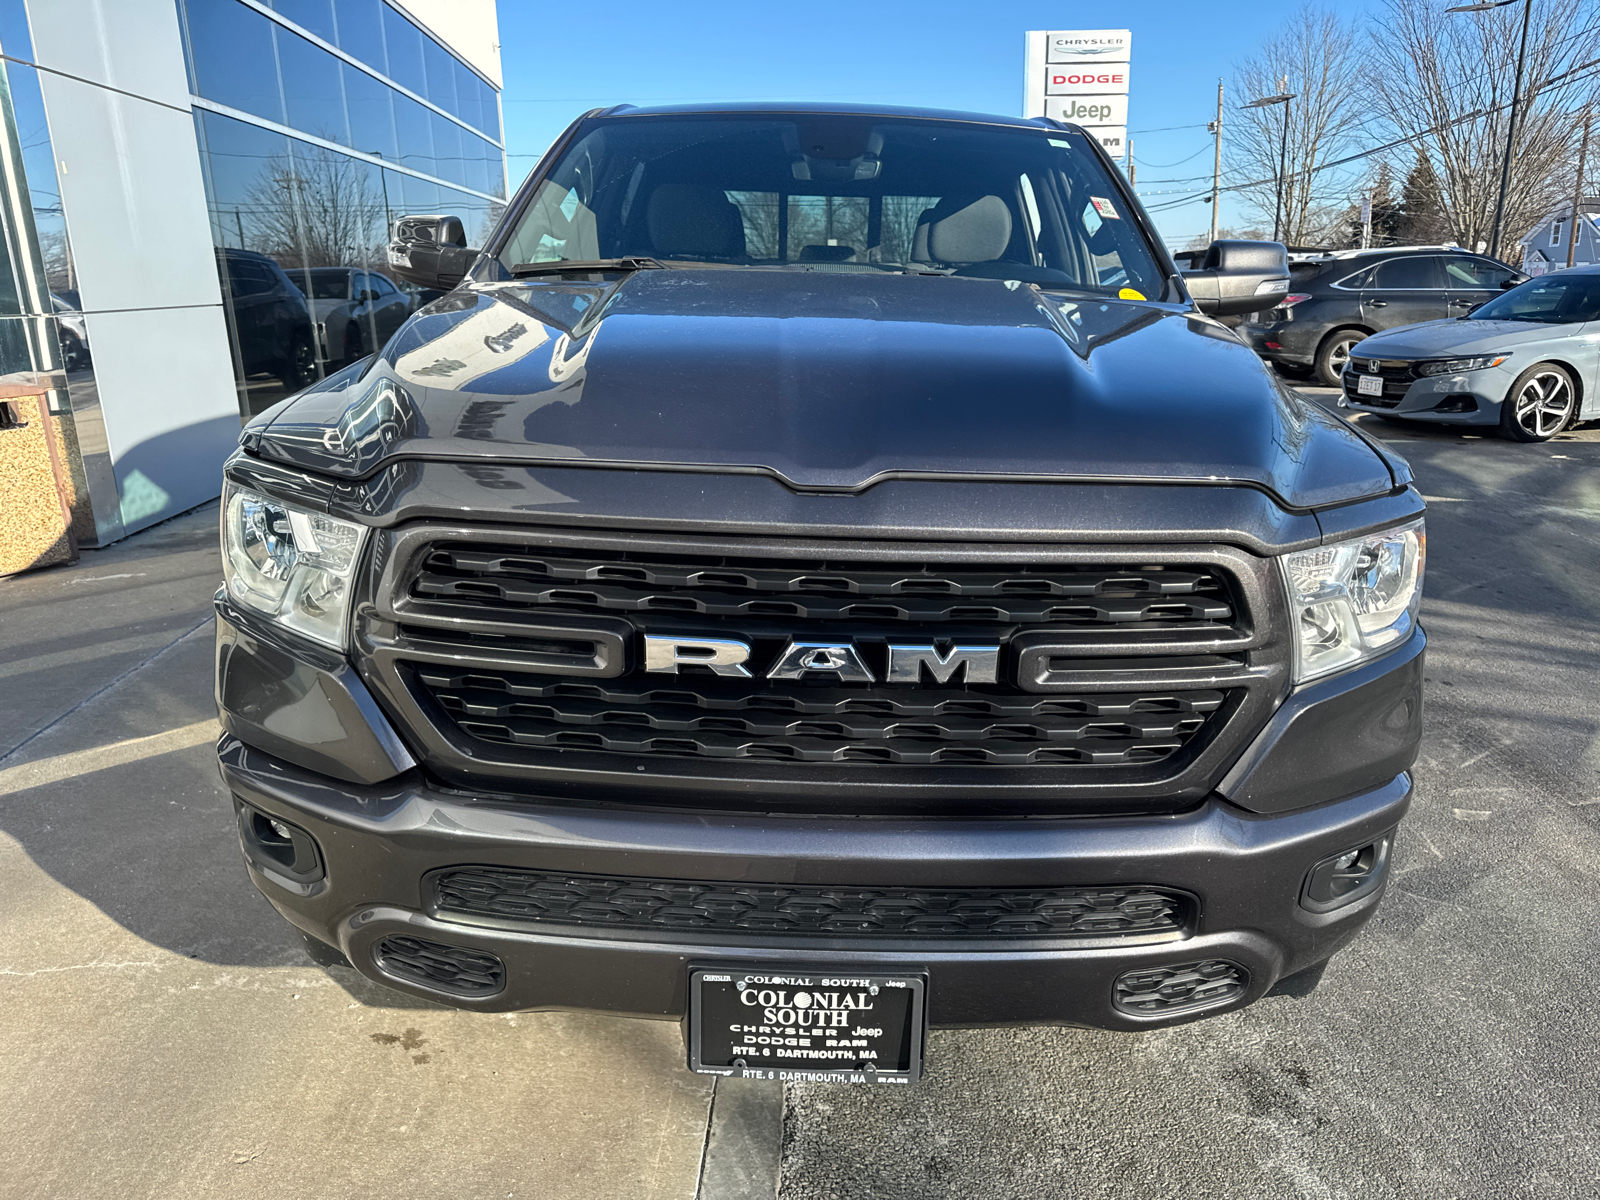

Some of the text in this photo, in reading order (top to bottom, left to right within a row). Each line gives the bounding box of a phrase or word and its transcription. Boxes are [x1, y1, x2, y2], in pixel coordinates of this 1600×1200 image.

[1053, 75, 1123, 84] DODGE
[1062, 101, 1111, 121] Jeep
[645, 634, 1001, 684] RAM
[744, 976, 870, 987] COLONIAL SOUTH
[885, 980, 906, 988] Jeep
[740, 989, 873, 1009] COLONIAL
[764, 1008, 849, 1027] SOUTH
[729, 1025, 883, 1037] CHRYSLER Jeep
[743, 1036, 868, 1047] DODGE RAM
[732, 1047, 878, 1060] RTE. 6 DARTMOUTH, MA
[742, 1070, 766, 1079] RTE.
[779, 1072, 848, 1083] DARTMOUTH,
[850, 1074, 866, 1082] MA
